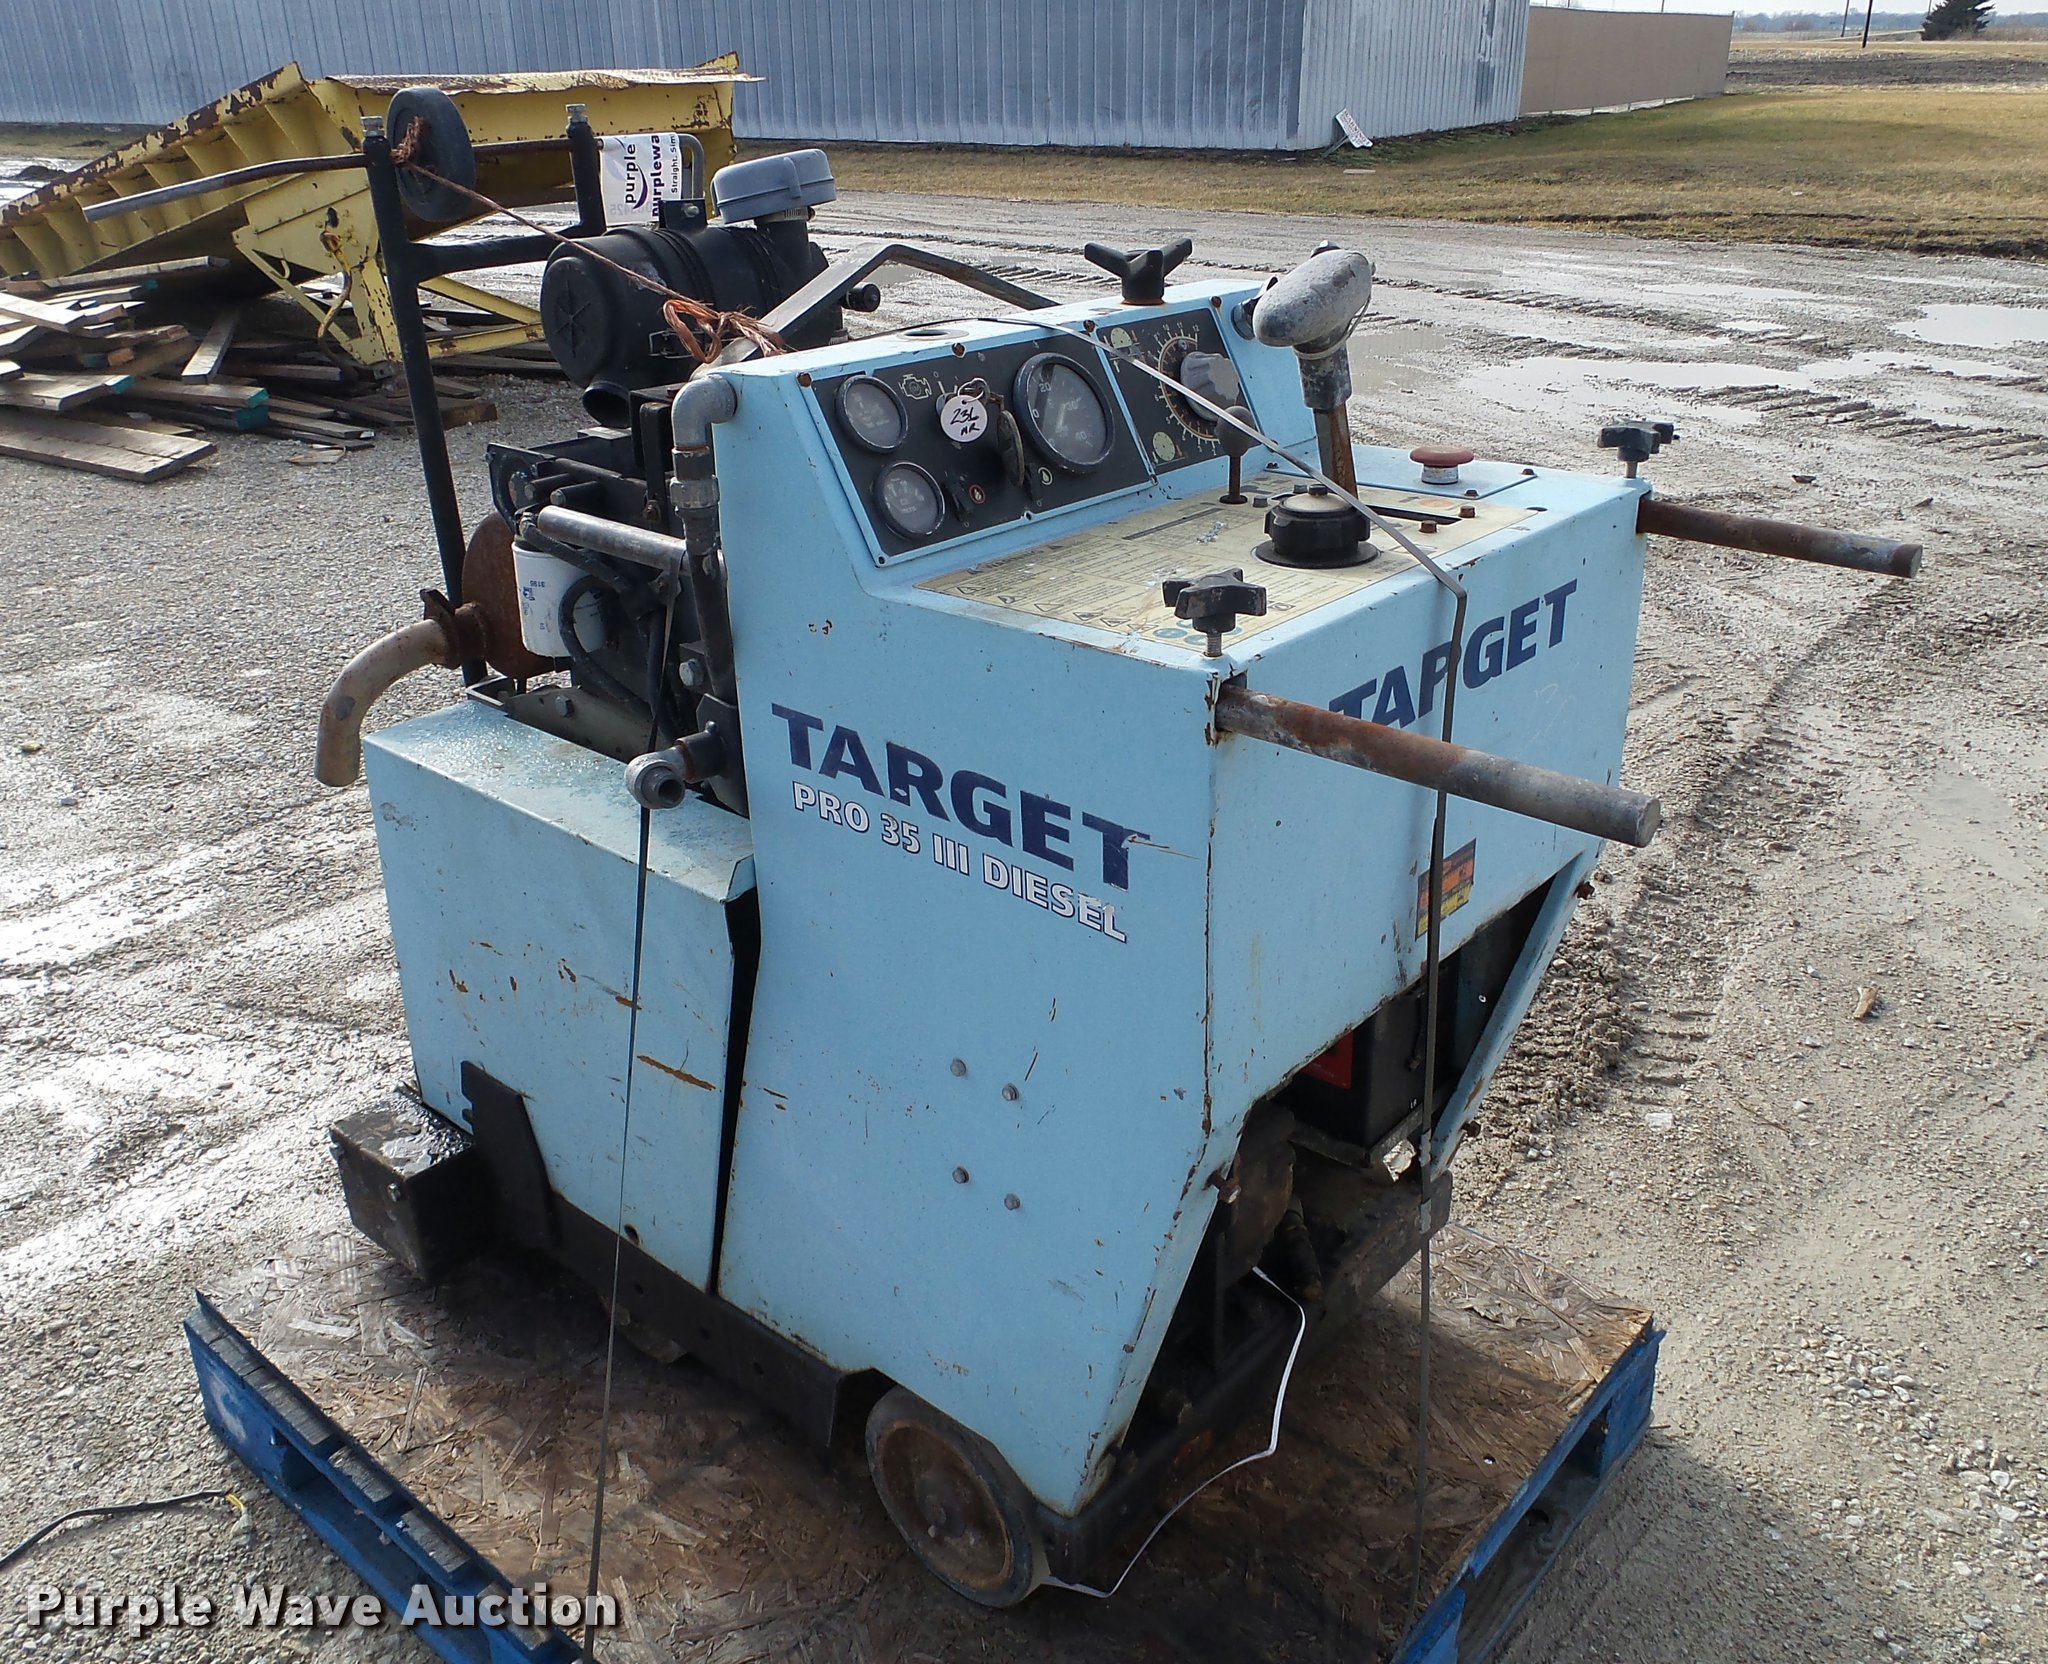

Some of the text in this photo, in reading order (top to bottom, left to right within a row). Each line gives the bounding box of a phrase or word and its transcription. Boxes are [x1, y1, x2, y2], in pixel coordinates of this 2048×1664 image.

[624, 144, 638, 204] purple
[770, 702, 1151, 892] TARGET
[792, 780, 1128, 943] PRO 35 III DIESEL
